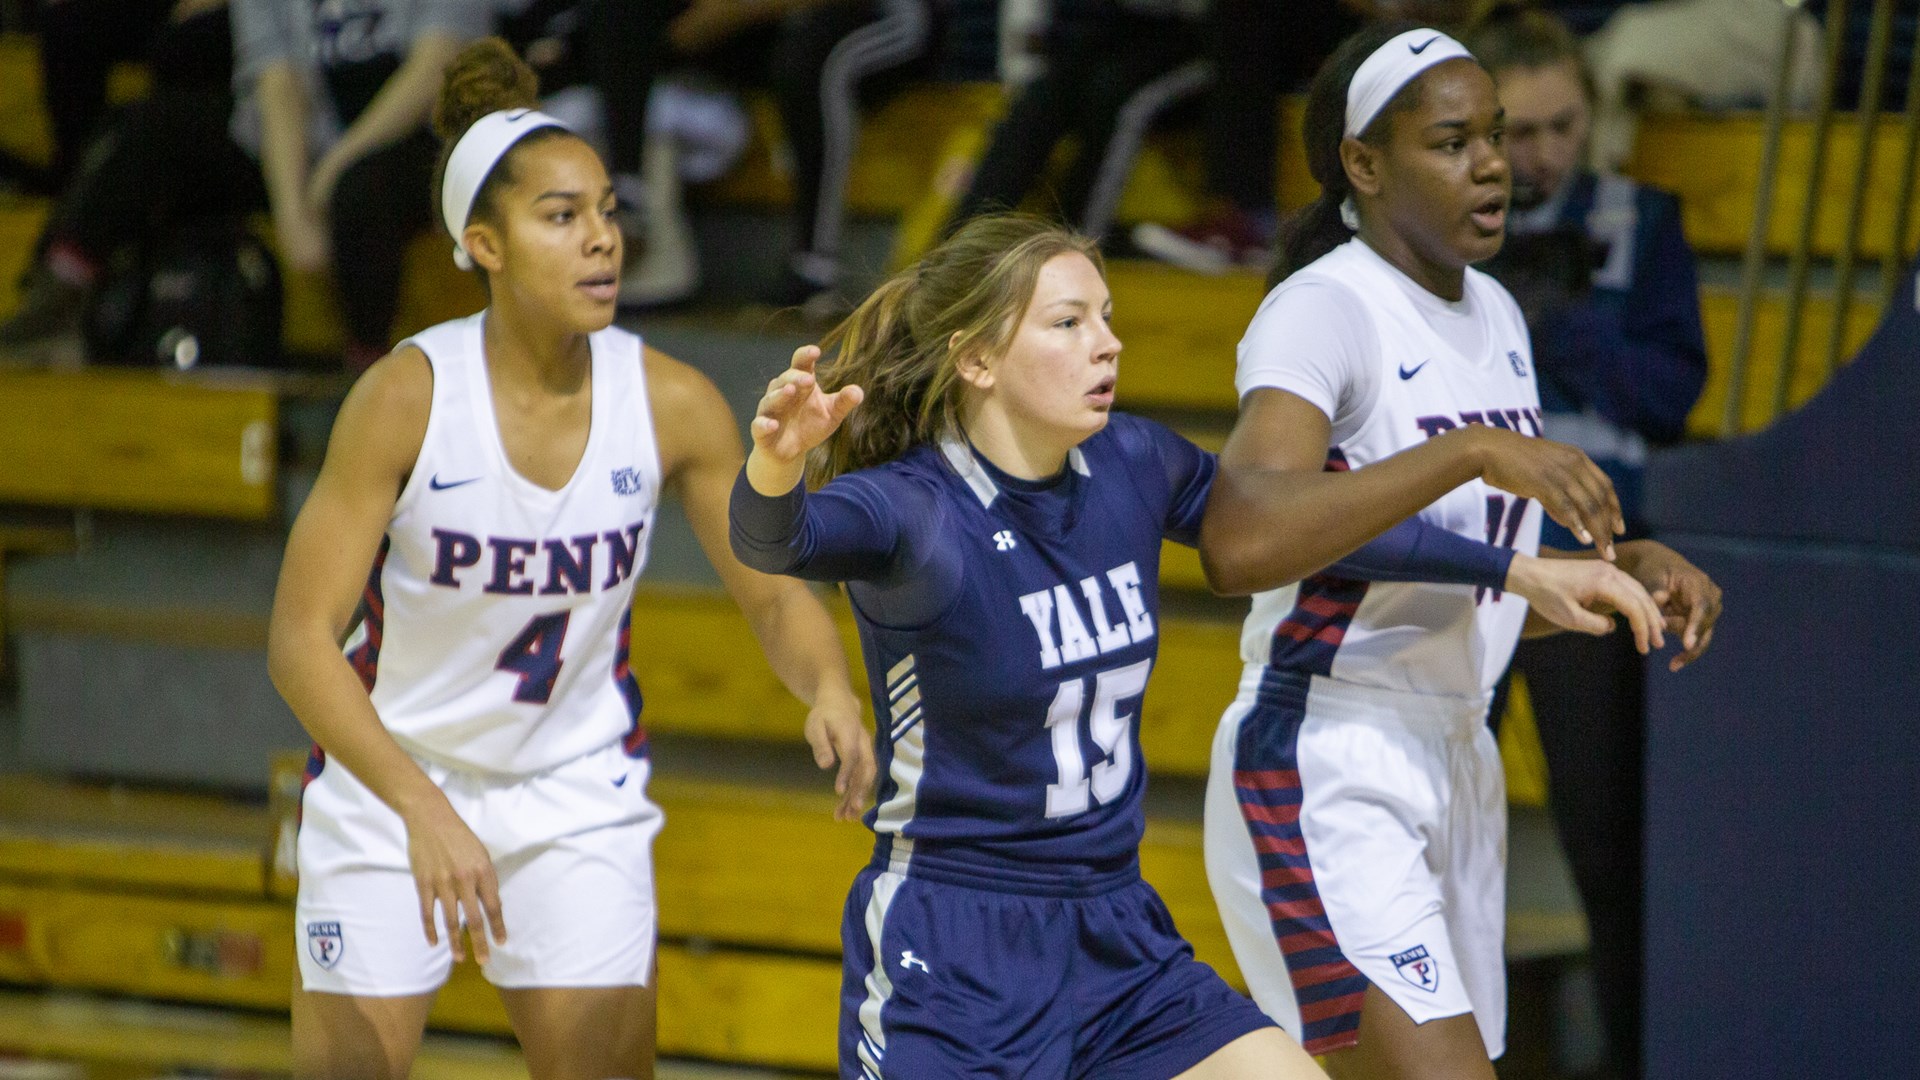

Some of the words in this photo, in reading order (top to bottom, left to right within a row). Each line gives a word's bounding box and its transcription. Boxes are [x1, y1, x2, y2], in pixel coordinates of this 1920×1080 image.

[429, 519, 644, 596] PENN
[494, 609, 571, 704] 4
[1019, 561, 1154, 669] YALE
[1044, 657, 1151, 819] 15
